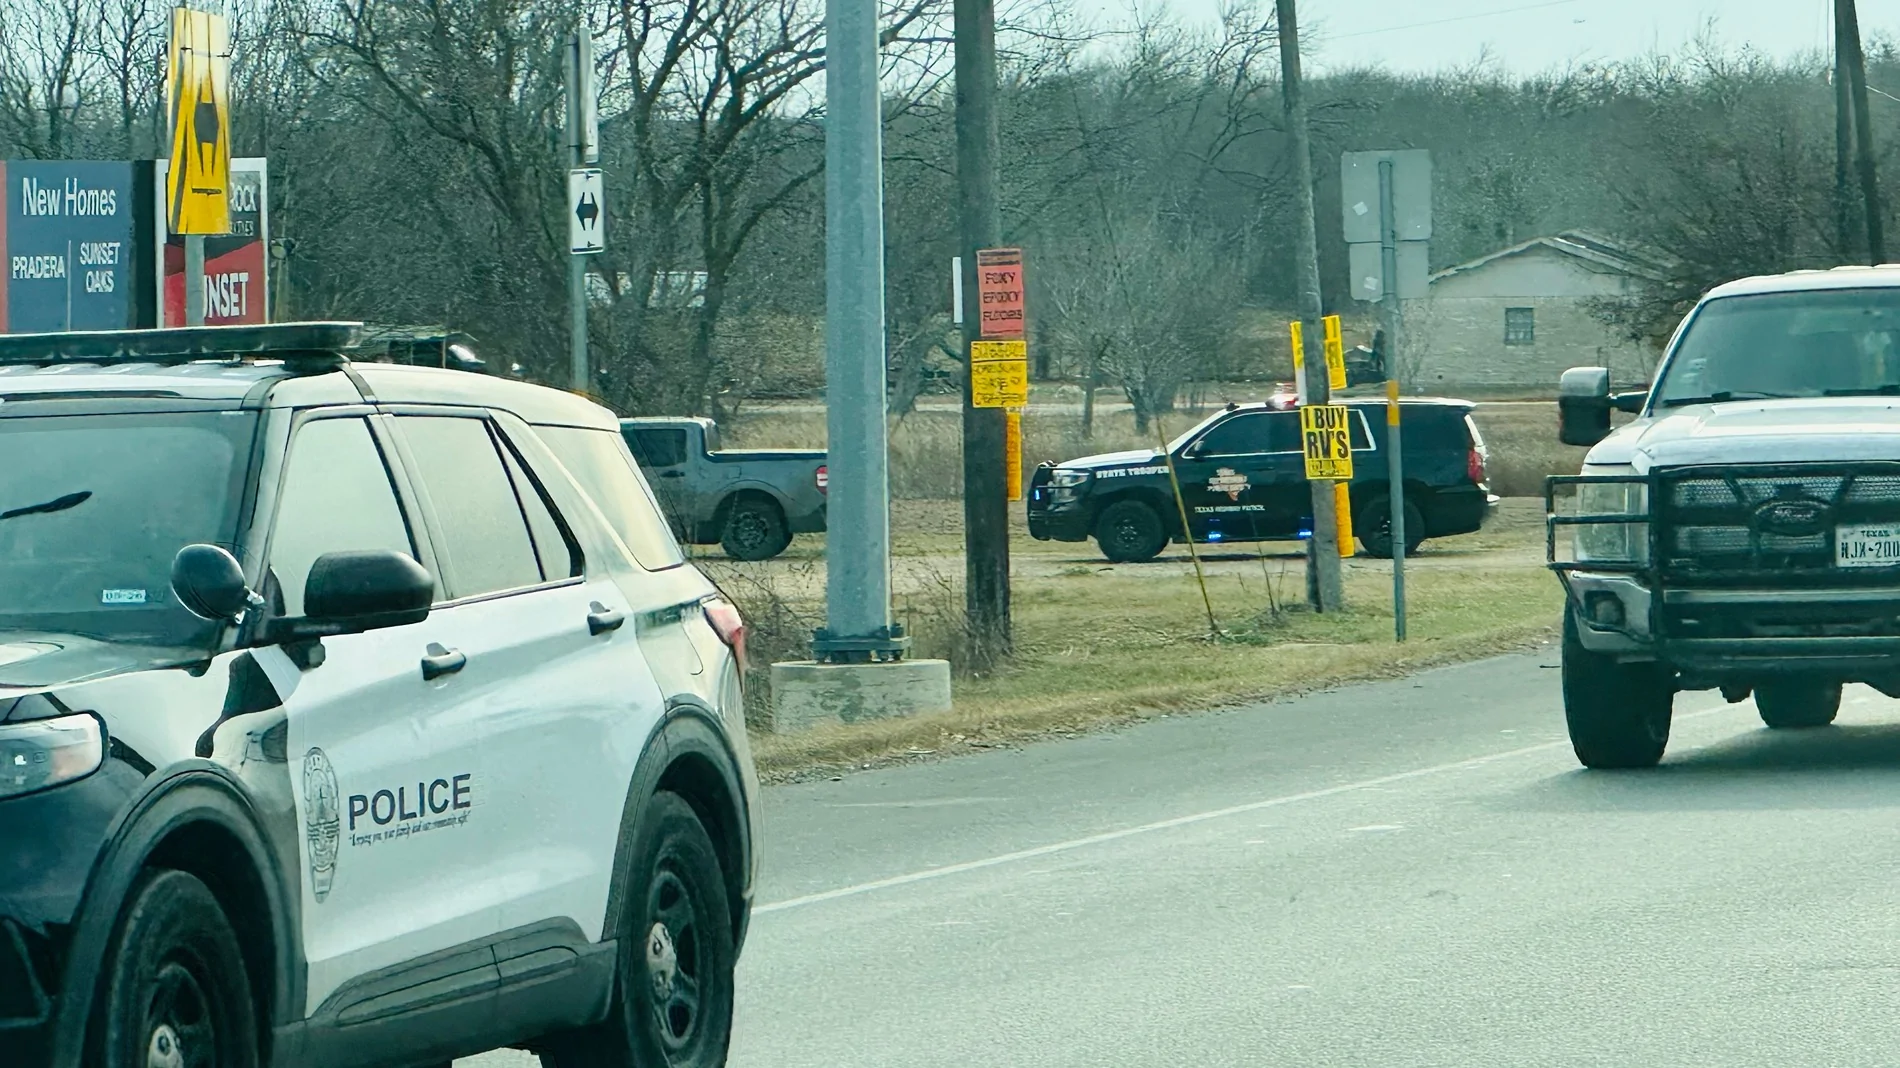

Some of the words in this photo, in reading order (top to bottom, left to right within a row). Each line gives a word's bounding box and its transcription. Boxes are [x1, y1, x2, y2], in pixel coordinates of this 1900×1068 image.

[22, 177, 61, 217] New
[65, 177, 117, 217] Homes
[80, 242, 121, 265] SUNSET
[12, 255, 66, 279] PRADERA
[985, 271, 1016, 285] FOXY
[86, 270, 115, 293] OAKS
[1304, 408, 1310, 429] I
[1314, 408, 1345, 429] BUY
[1306, 430, 1349, 459] RV'S
[1096, 468, 1126, 479] STATE
[348, 773, 471, 831] POLICE
